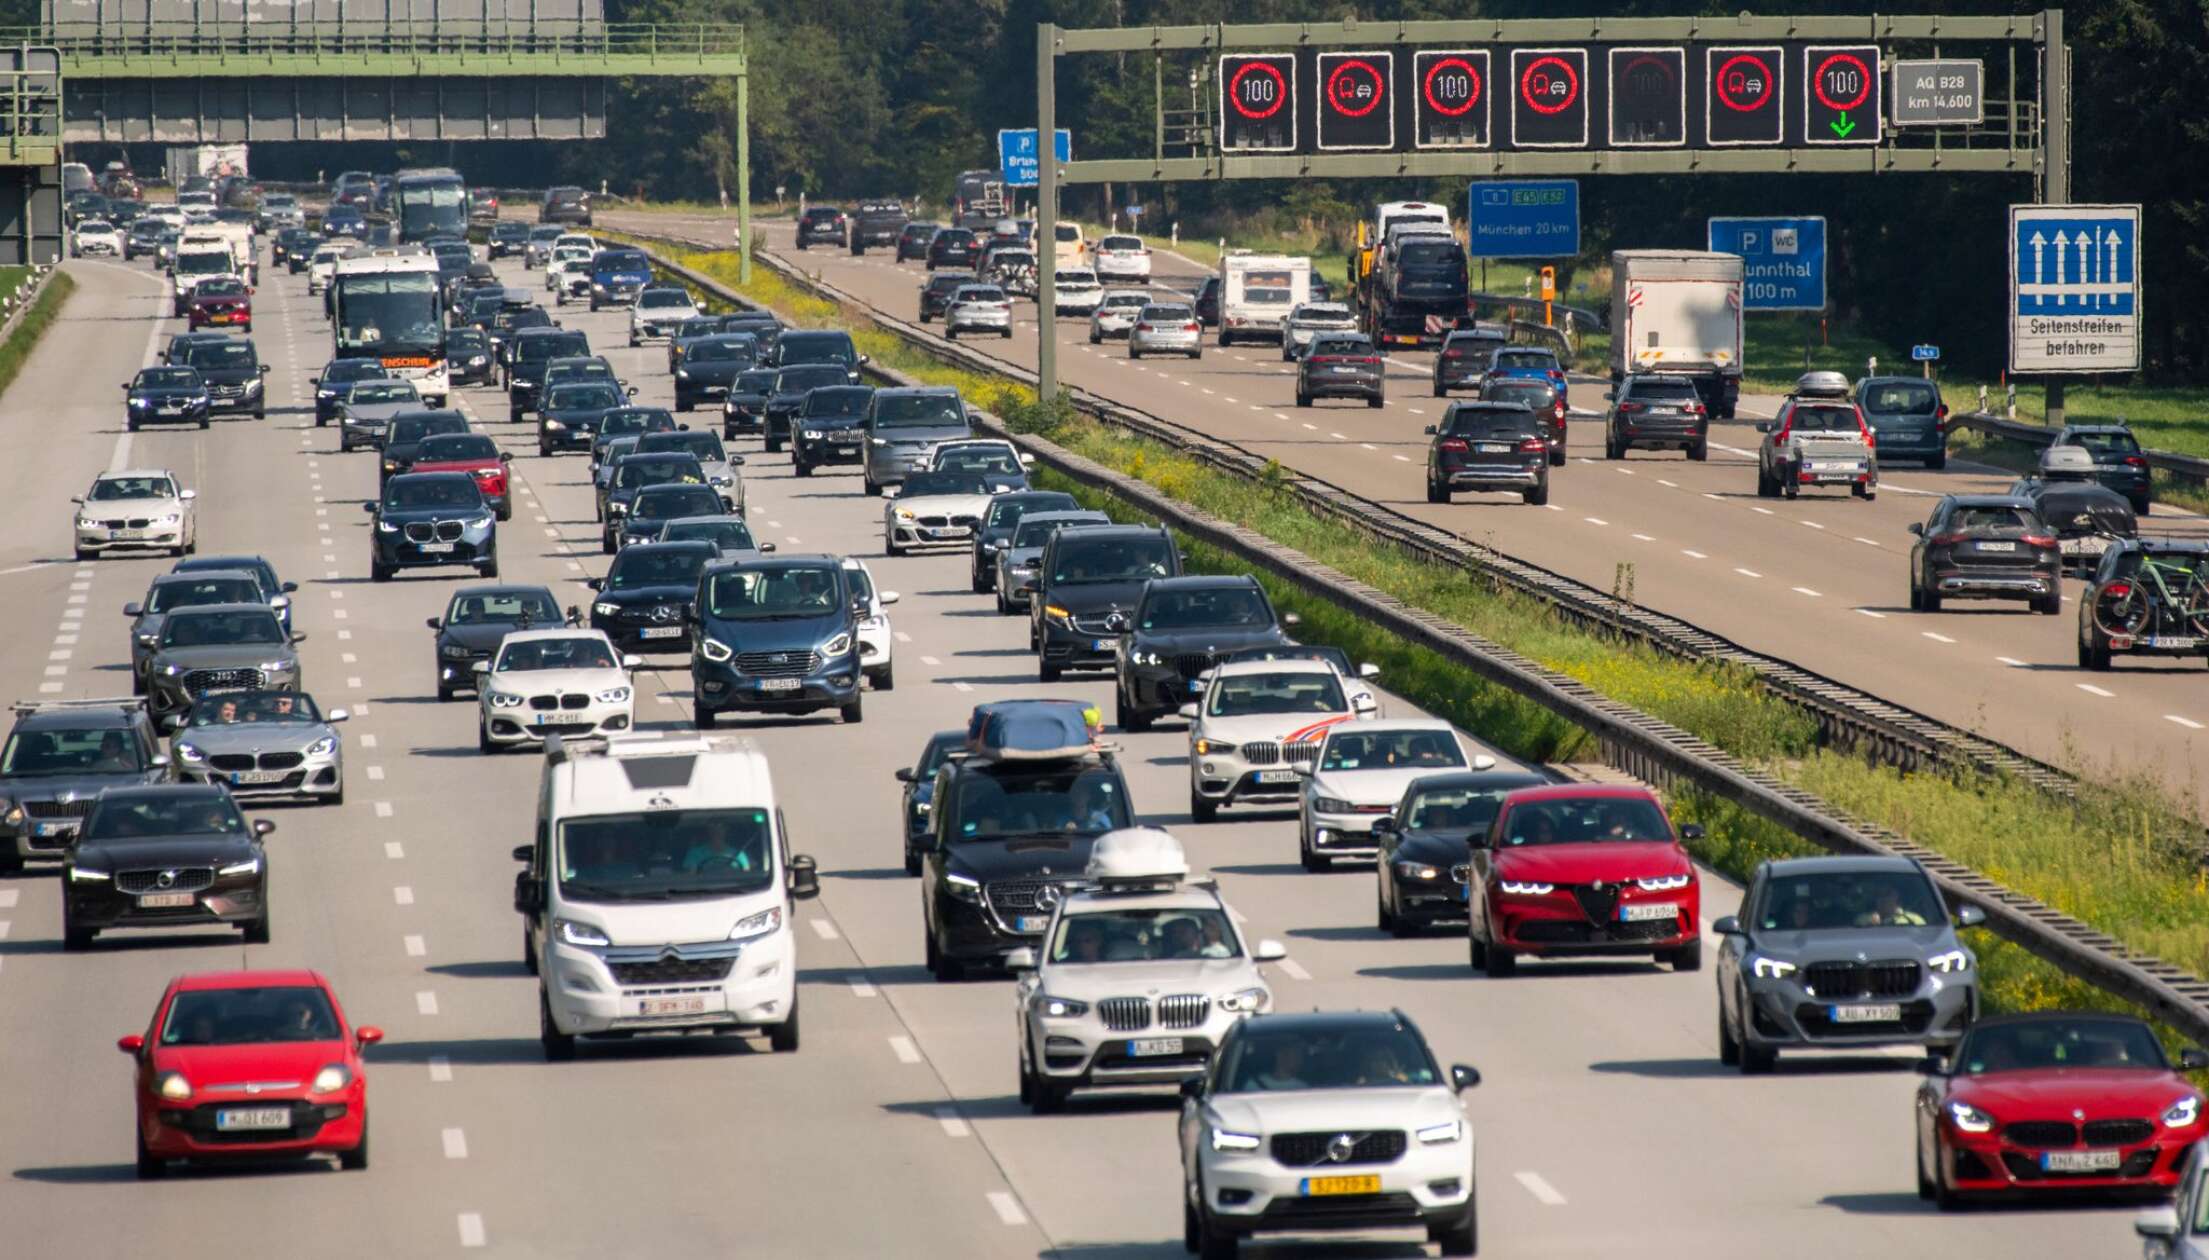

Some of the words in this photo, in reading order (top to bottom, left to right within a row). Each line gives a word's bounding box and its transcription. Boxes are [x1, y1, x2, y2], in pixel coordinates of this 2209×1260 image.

[1438, 75, 1468, 98] 100
[1827, 71, 1858, 94] 100
[1915, 77, 1935, 90] AQ
[1940, 76, 1965, 89] B28
[1243, 79, 1274, 102] 100
[1908, 96, 1929, 109] km
[1020, 137, 1030, 152] P
[1008, 156, 1038, 167] Brun
[1478, 224, 1532, 235] München
[1536, 222, 1550, 235] 20
[1552, 222, 1570, 234] km
[1743, 232, 1757, 251] P
[1775, 236, 1795, 248] WC
[1744, 262, 1812, 277] unnthal
[1747, 283, 1776, 300] 100
[1780, 287, 1797, 299] m
[2030, 318, 2123, 334] Seitenstreifen
[2046, 340, 2105, 356] befahren
[382, 357, 430, 368] ENSCHEIN
